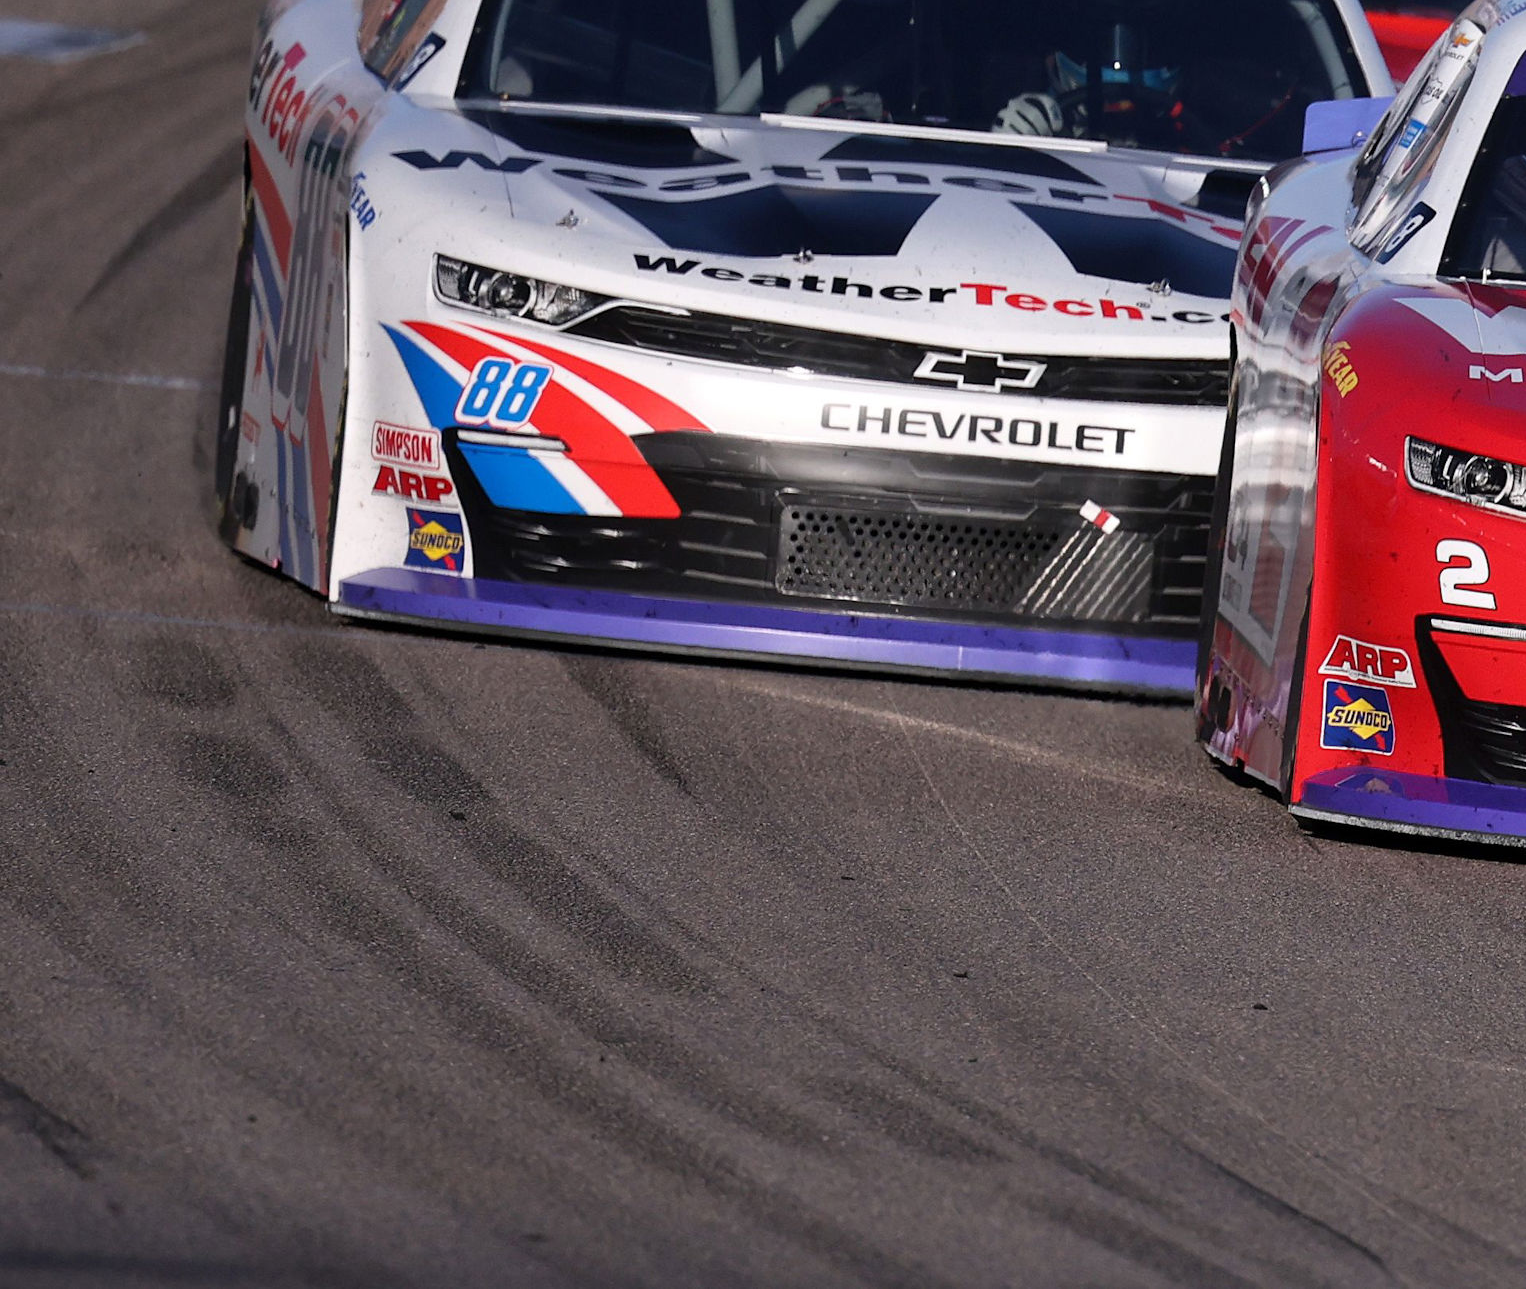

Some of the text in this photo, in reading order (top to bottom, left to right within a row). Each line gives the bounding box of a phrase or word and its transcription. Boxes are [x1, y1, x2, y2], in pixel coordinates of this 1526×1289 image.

[459, 357, 552, 423] 88
[375, 427, 433, 464] SIMPSON
[820, 402, 1136, 456] CHEVROLET
[372, 465, 454, 502] ARP
[412, 529, 462, 551] SUNOCO
[1436, 538, 1497, 610] 2
[1326, 639, 1408, 680] ARP
[1332, 708, 1388, 729] SUNOCO
